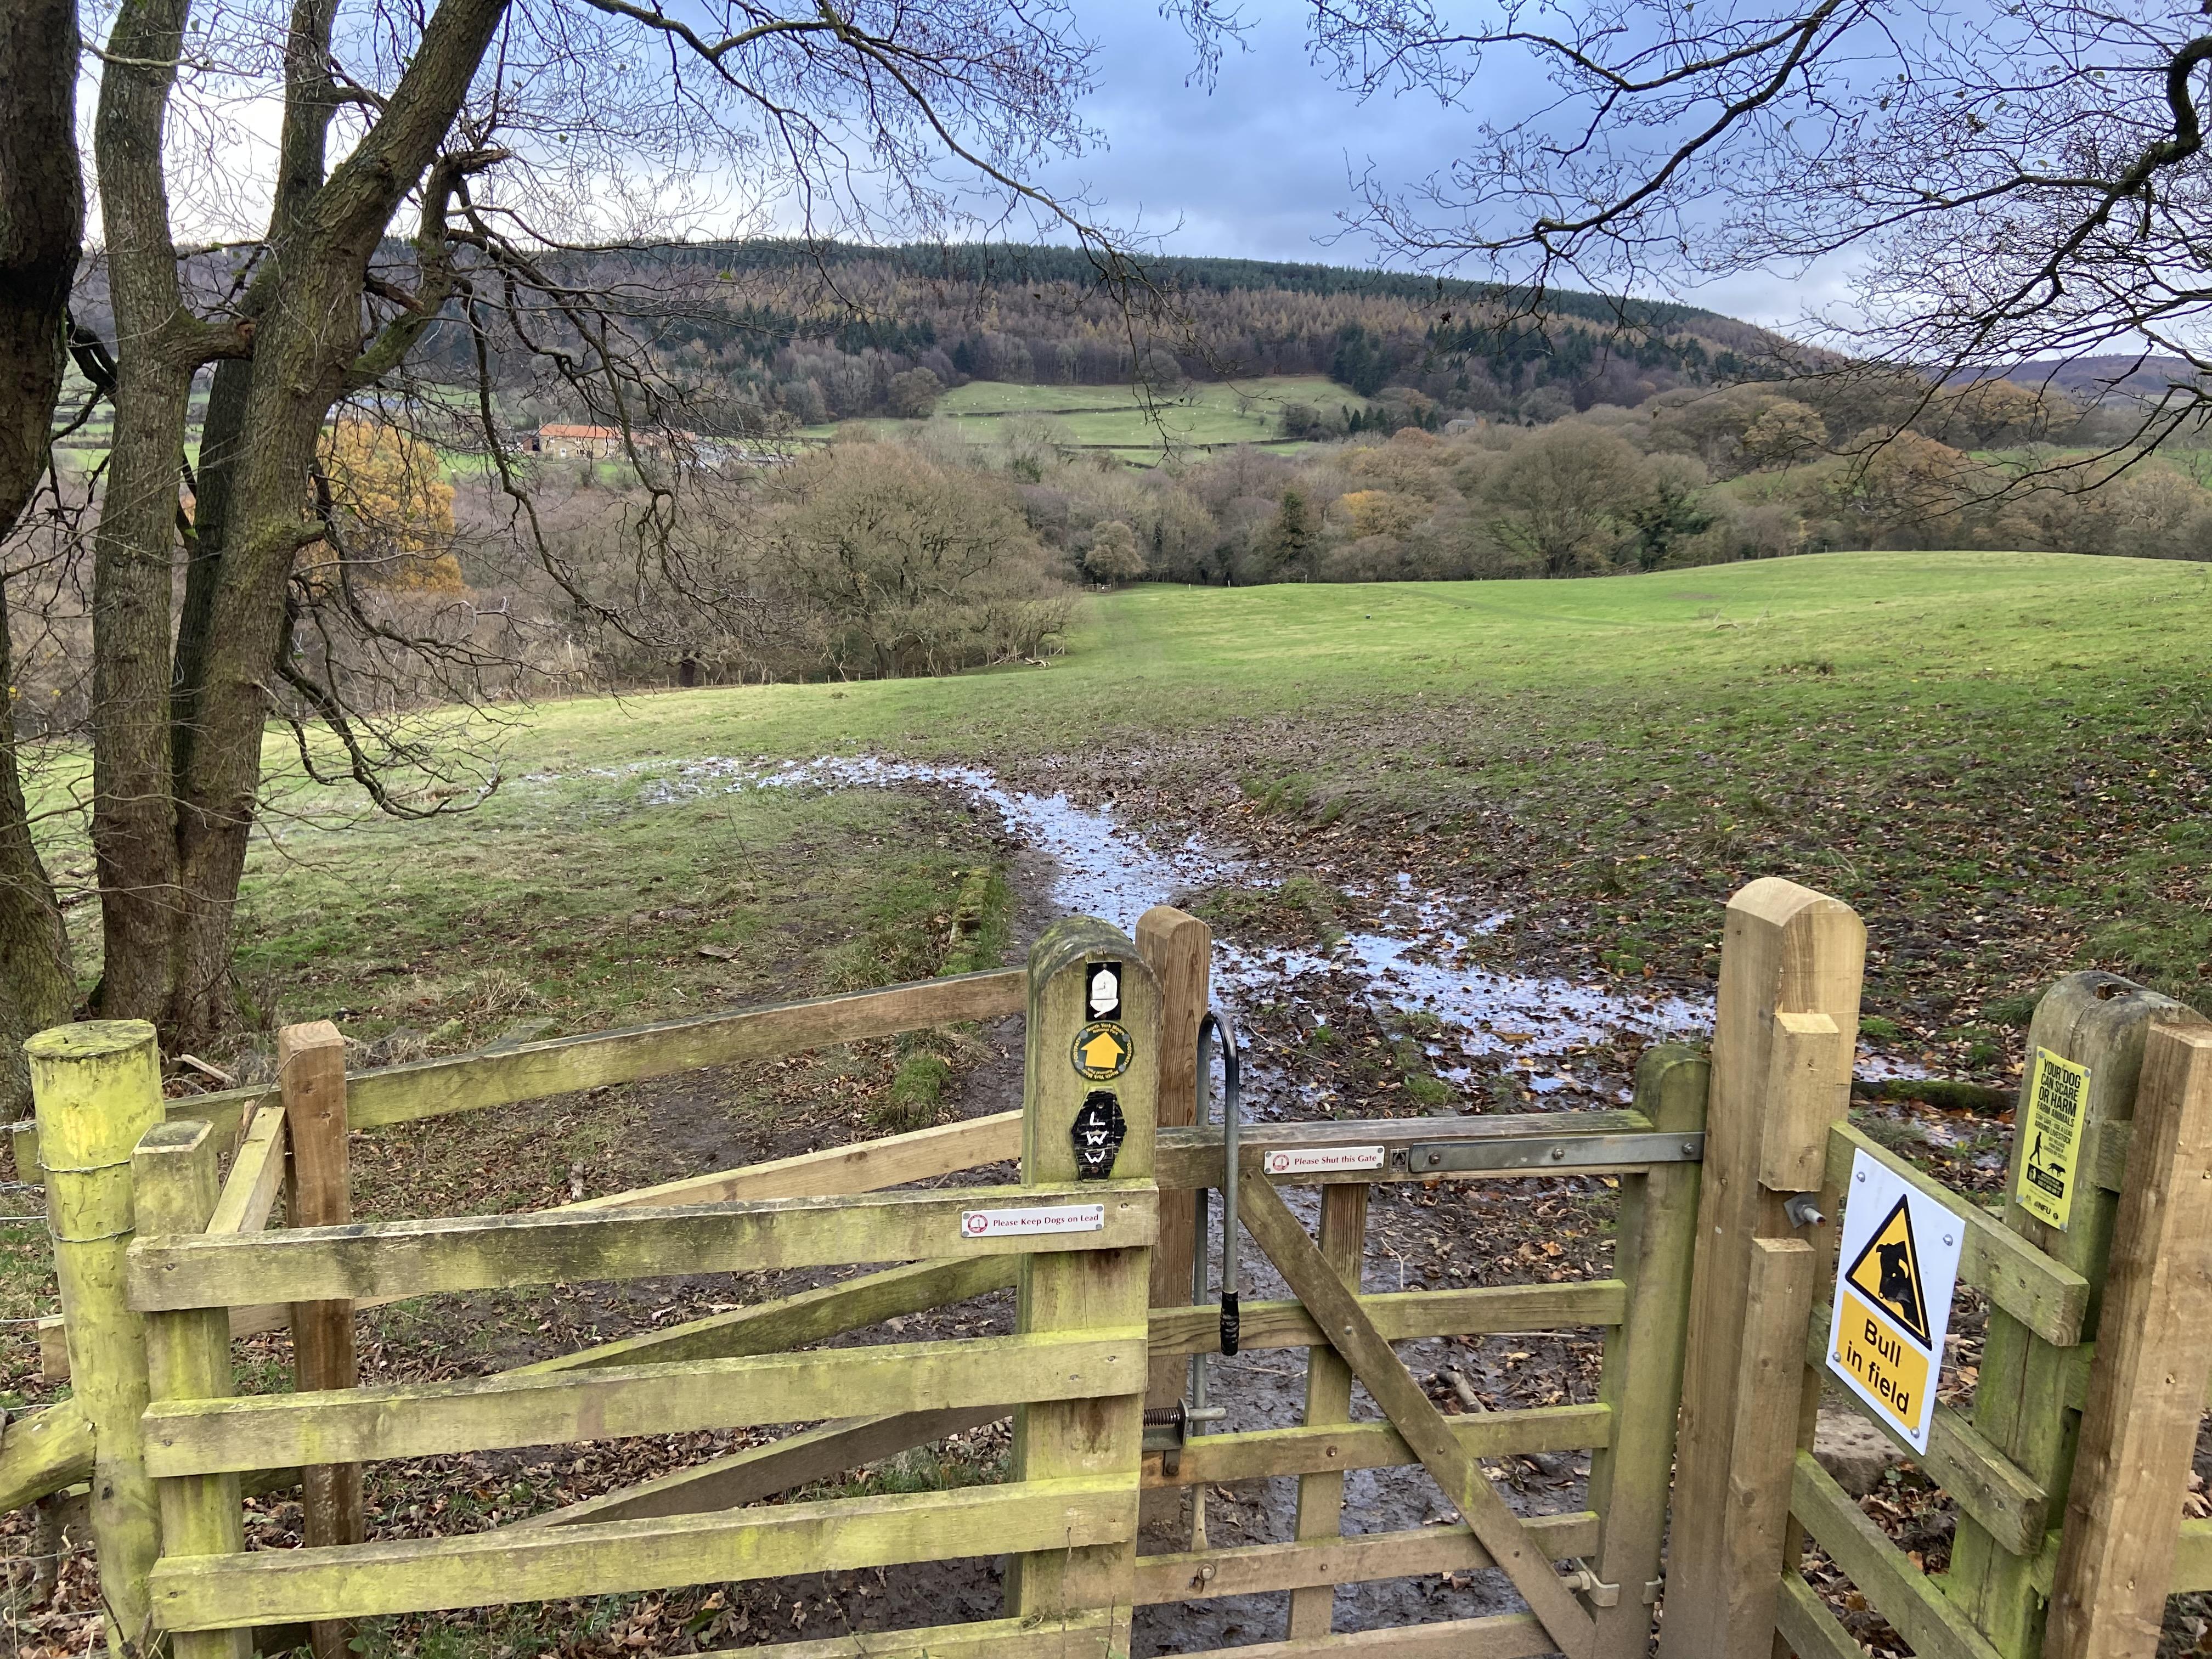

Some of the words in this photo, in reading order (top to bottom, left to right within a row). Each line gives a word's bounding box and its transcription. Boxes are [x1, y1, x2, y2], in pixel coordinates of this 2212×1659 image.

[1086, 1024, 1100, 1032] North
[2044, 1058, 2061, 1081] YOUR
[2063, 1069, 2081, 1088] DOG
[2041, 1073, 2054, 1090] CAN
[2055, 1081, 2079, 1102] SCARE
[2036, 1101, 2051, 1115] FARM
[2051, 1108, 2074, 1127] ANIMALS
[2039, 1086, 2050, 1104] OR
[2050, 1092, 2077, 1118] HARM
[2050, 1128, 2071, 1145] LIVESTOCK
[1294, 1157, 1319, 1165] Please
[1021, 1218, 1042, 1226] Keep
[1045, 1216, 1065, 1225] Dogs
[1080, 1214, 1098, 1222] Lead
[2038, 1202, 2051, 1215] NFU
[1864, 1318, 1901, 1368] Bull
[1847, 1340, 1863, 1373] in
[1868, 1362, 1909, 1415] field
